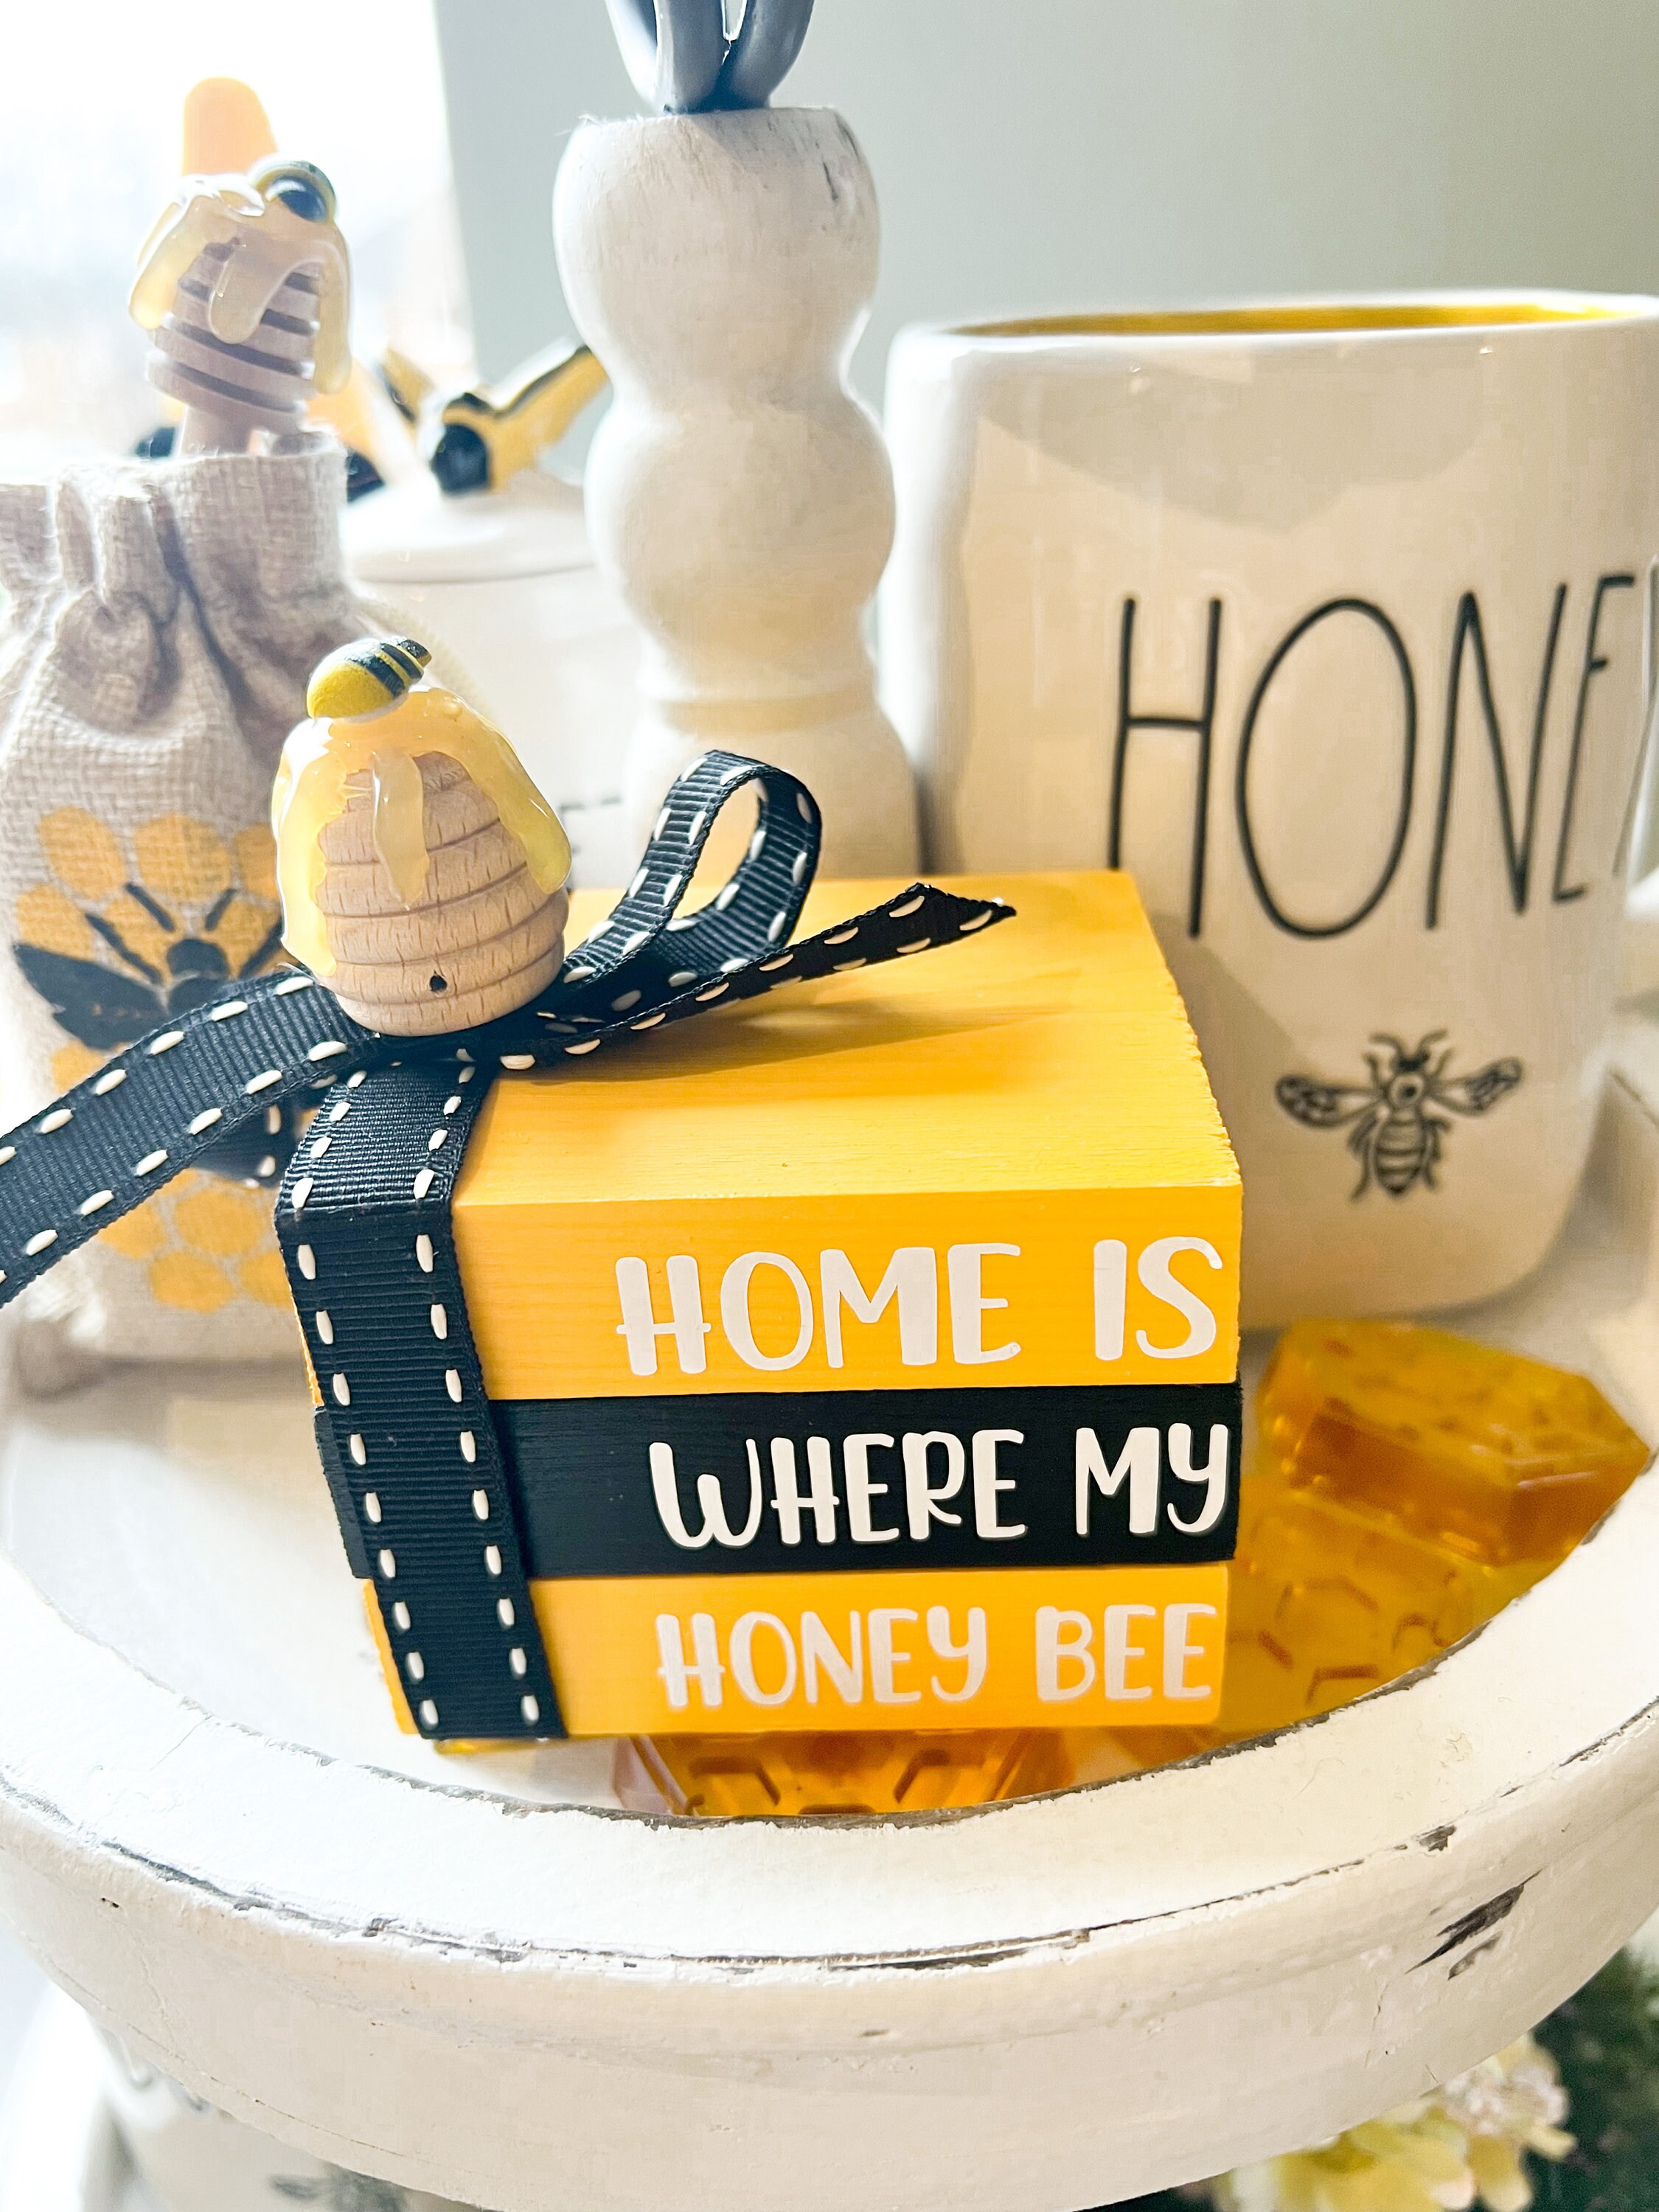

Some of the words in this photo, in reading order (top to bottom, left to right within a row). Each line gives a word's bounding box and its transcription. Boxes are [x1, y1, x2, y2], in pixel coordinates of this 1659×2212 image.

[616, 1243, 1021, 1376] HOME
[1093, 1237, 1222, 1360] IS
[649, 1430, 1028, 1548] WHERE
[1076, 1422, 1229, 1536] MY
[656, 1606, 988, 1708] HONEY
[1035, 1603, 1217, 1703] BEE
